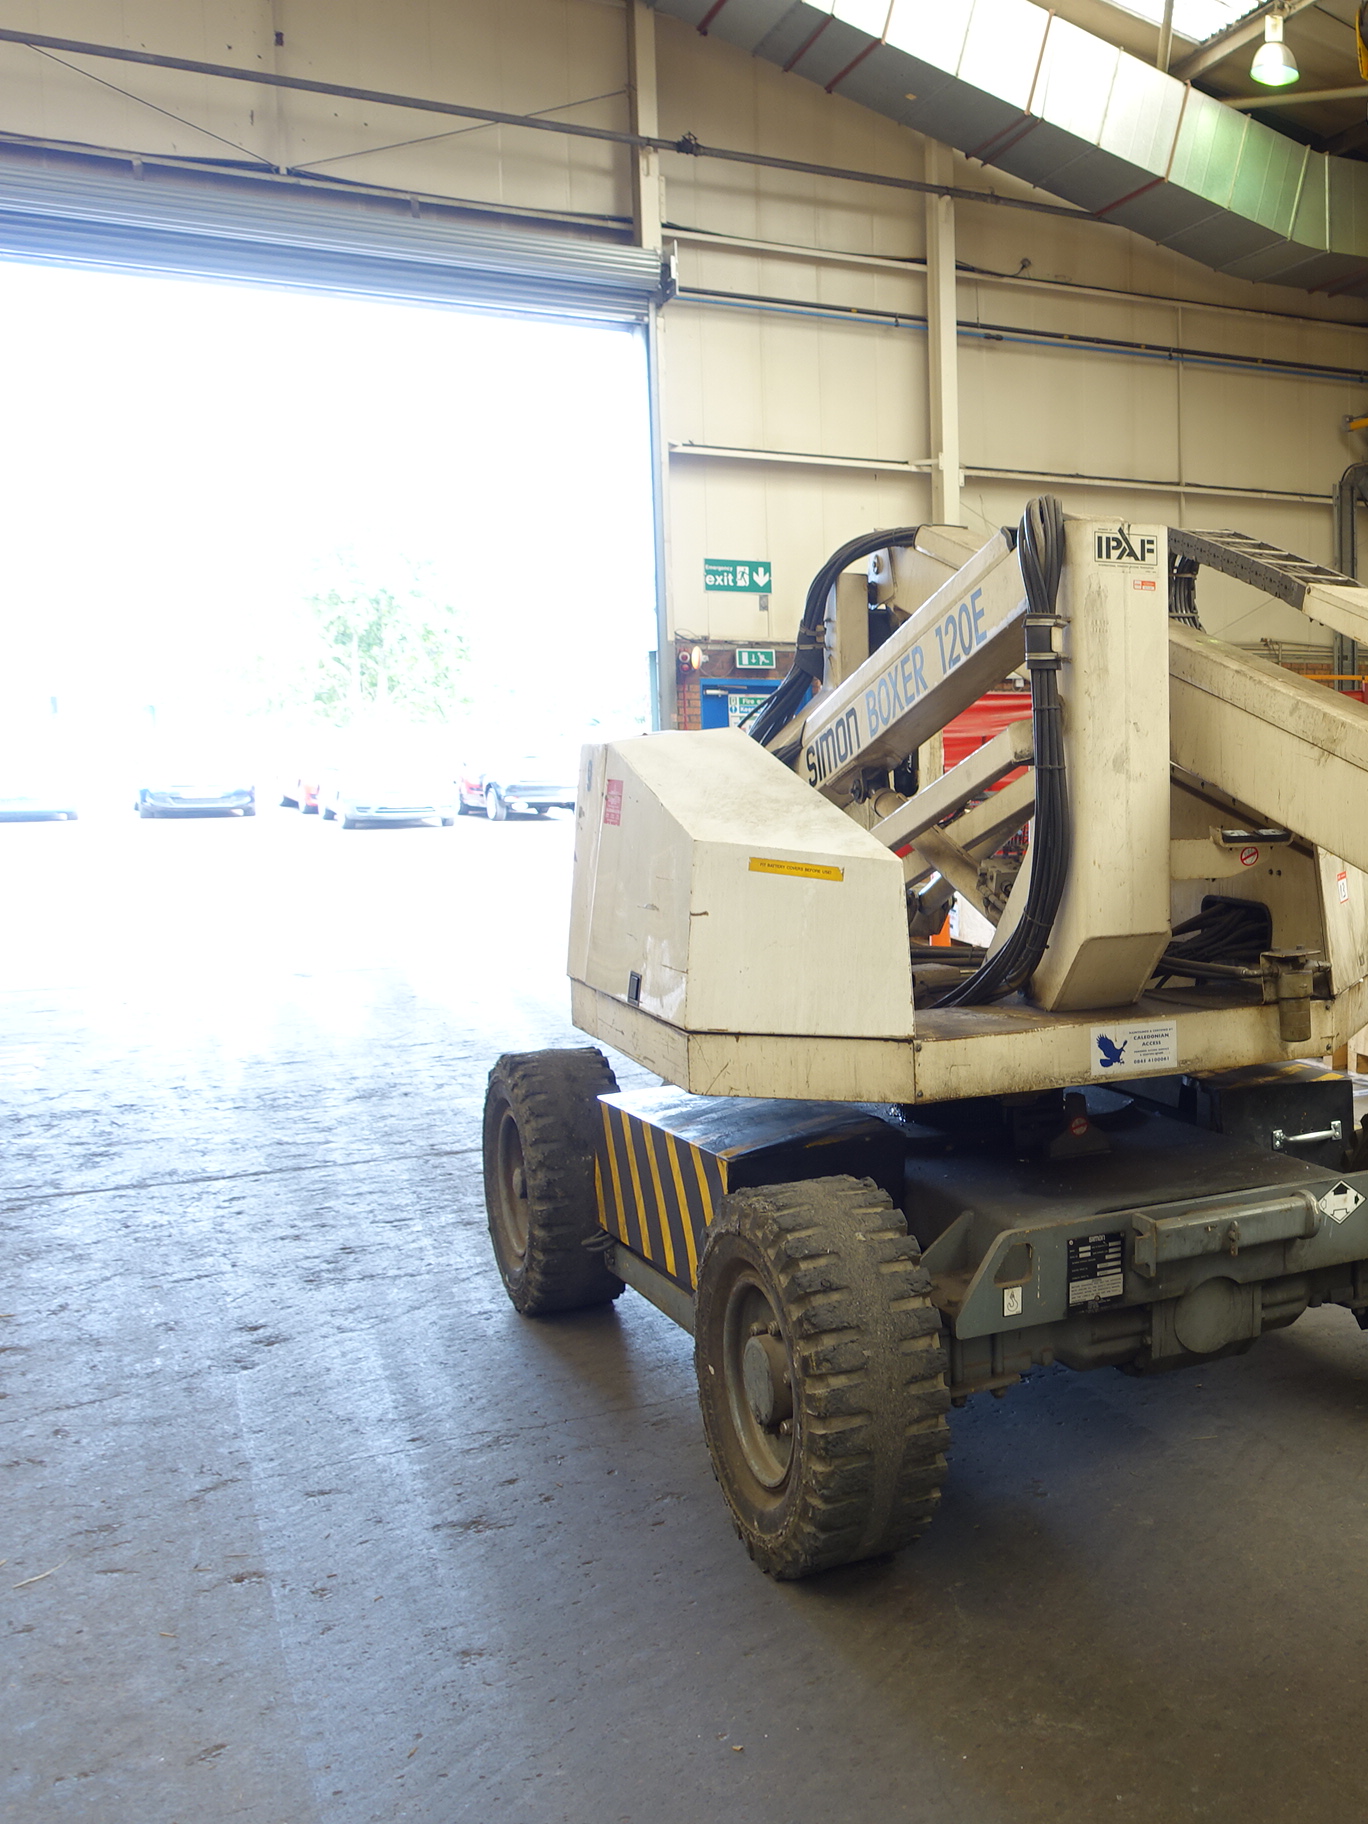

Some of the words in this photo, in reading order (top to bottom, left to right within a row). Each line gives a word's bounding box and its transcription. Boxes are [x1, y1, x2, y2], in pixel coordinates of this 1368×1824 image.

[1097, 526, 1155, 562] IPAF
[705, 572, 735, 586] exit
[865, 645, 928, 738] BOXER
[934, 587, 988, 675] 120E
